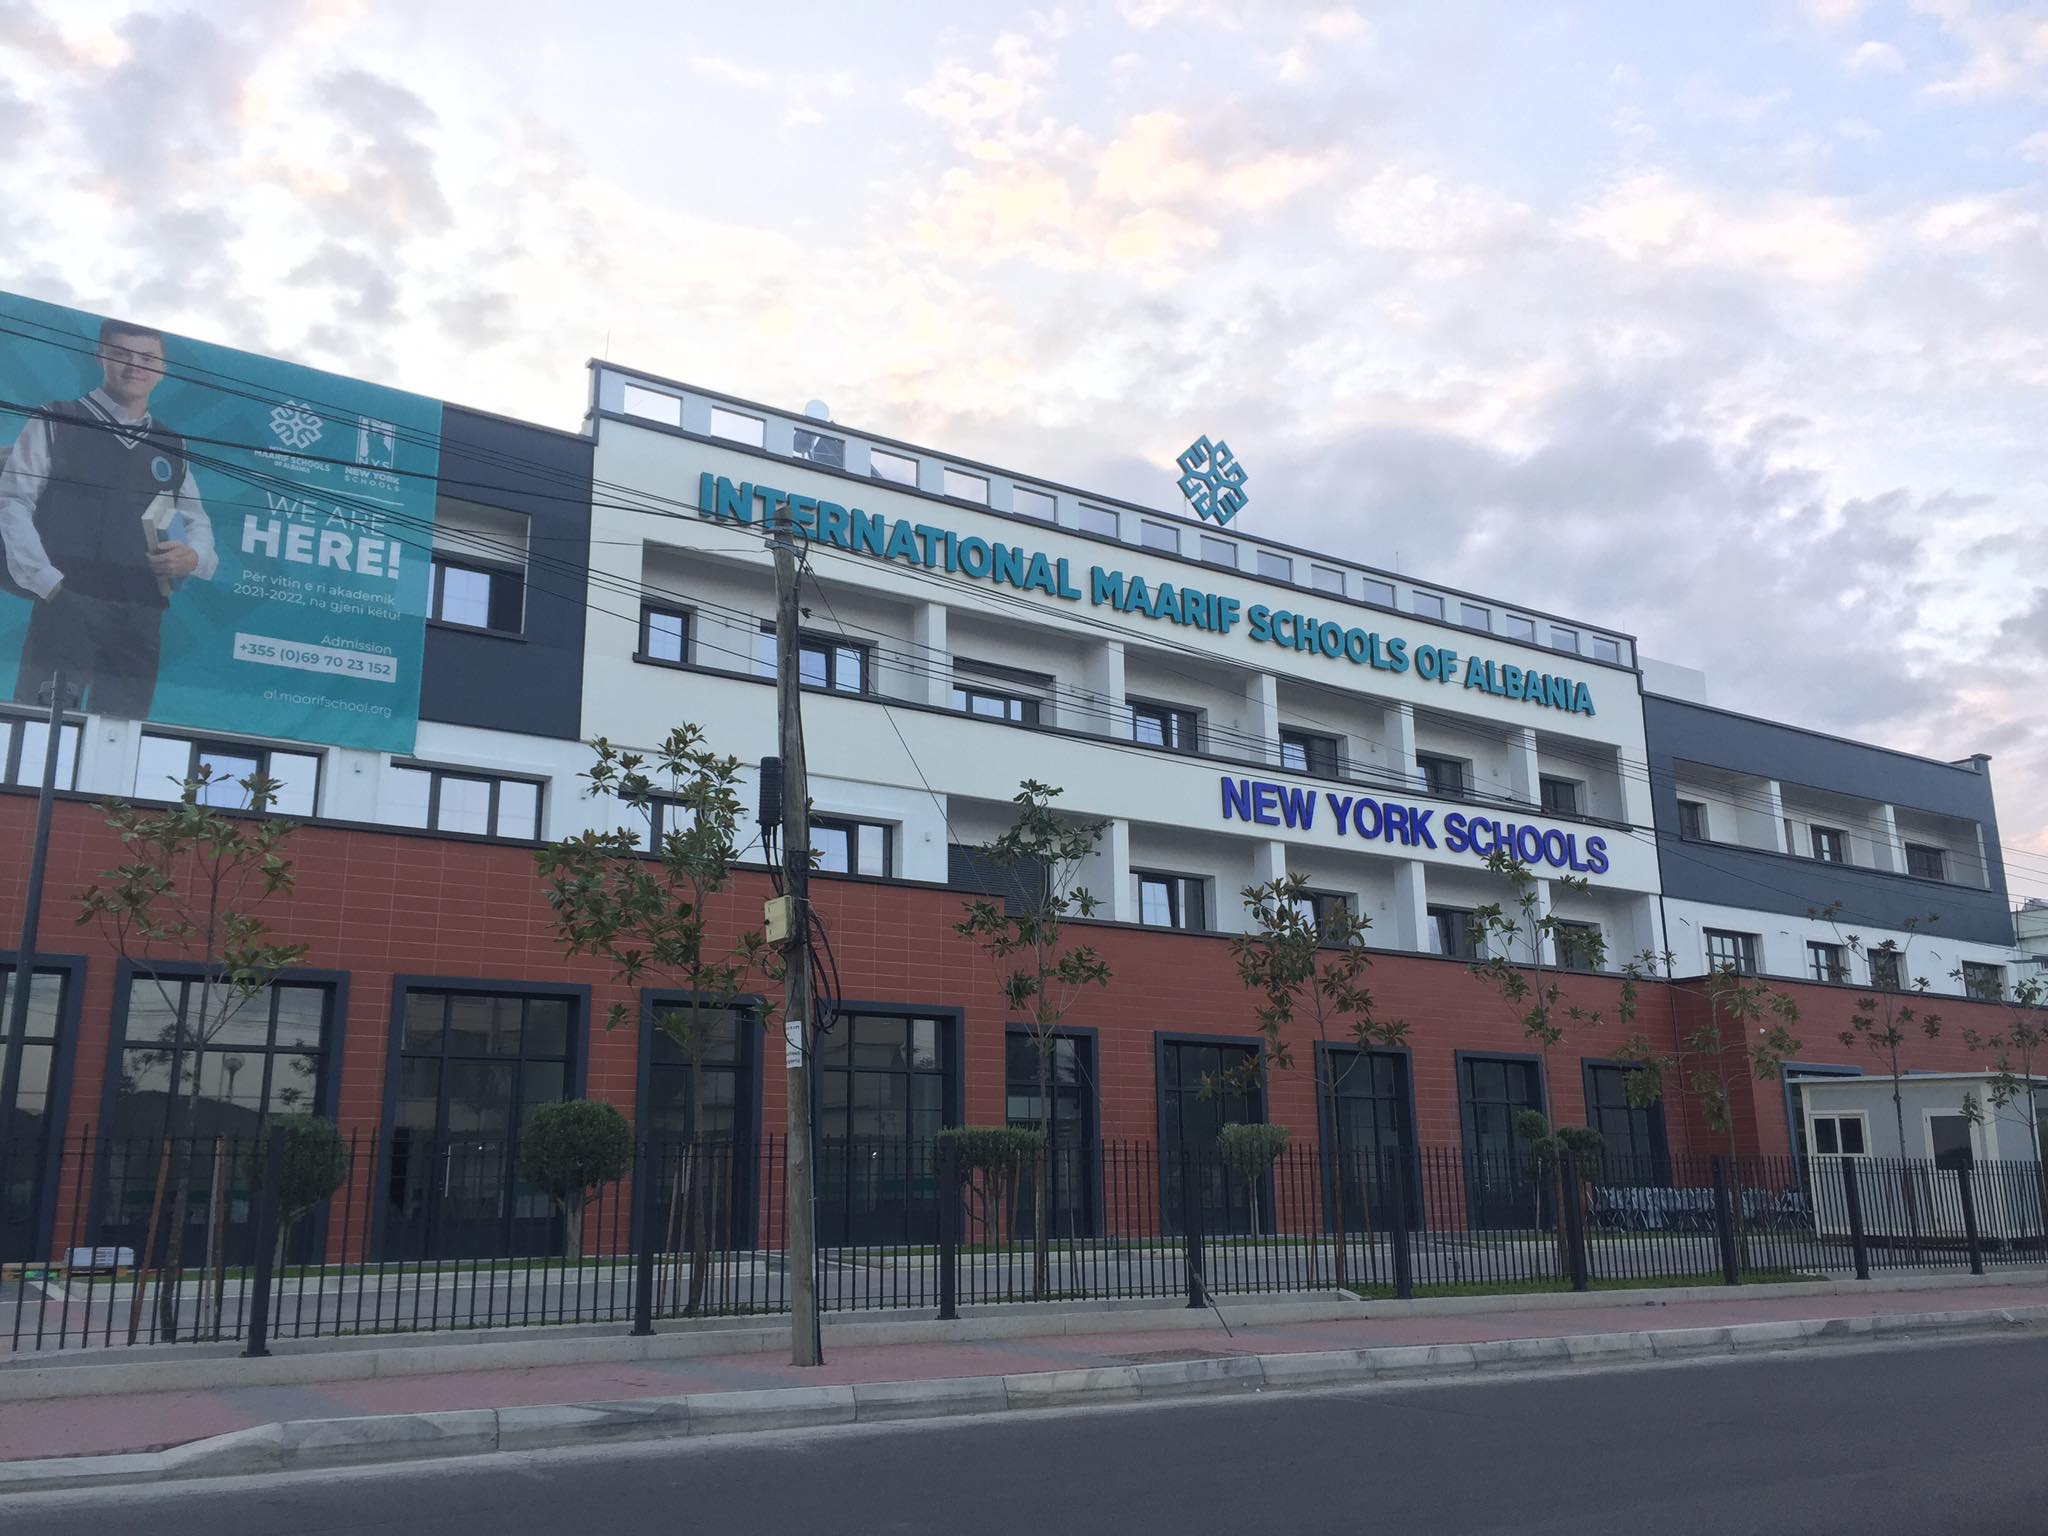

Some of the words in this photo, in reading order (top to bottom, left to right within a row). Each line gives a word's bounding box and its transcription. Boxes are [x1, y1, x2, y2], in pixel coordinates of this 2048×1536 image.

[344, 466, 370, 478] NEW
[371, 471, 400, 485] YORK
[344, 475, 400, 492] SCHOOLS
[266, 491, 318, 524] WE
[325, 506, 387, 537] ARE
[241, 513, 402, 580] HERE!
[233, 583, 306, 606] 2021-2022,
[309, 597, 327, 608] na
[330, 599, 364, 615] gjeni
[270, 575, 300, 590] vitin
[304, 582, 313, 591] e
[316, 583, 326, 593] ri
[328, 585, 396, 606] akademik
[699, 472, 1082, 600] INTERNATIONAL
[1090, 565, 1241, 634] MAARIF
[1248, 604, 1410, 674] SCHOOLS
[1415, 645, 1458, 684] OF
[1464, 655, 1597, 718] ALBANIA
[240, 643, 275, 658] +355
[280, 648, 320, 664] (0)69
[324, 655, 344, 668] 70
[347, 658, 364, 671] 23
[368, 662, 391, 675] 152
[320, 634, 393, 655] Admission
[263, 688, 393, 719] al.maarifschool.org
[1220, 776, 1318, 832] NEW
[1325, 793, 1437, 850] YORK
[1444, 812, 1610, 875] SCHOOLS
